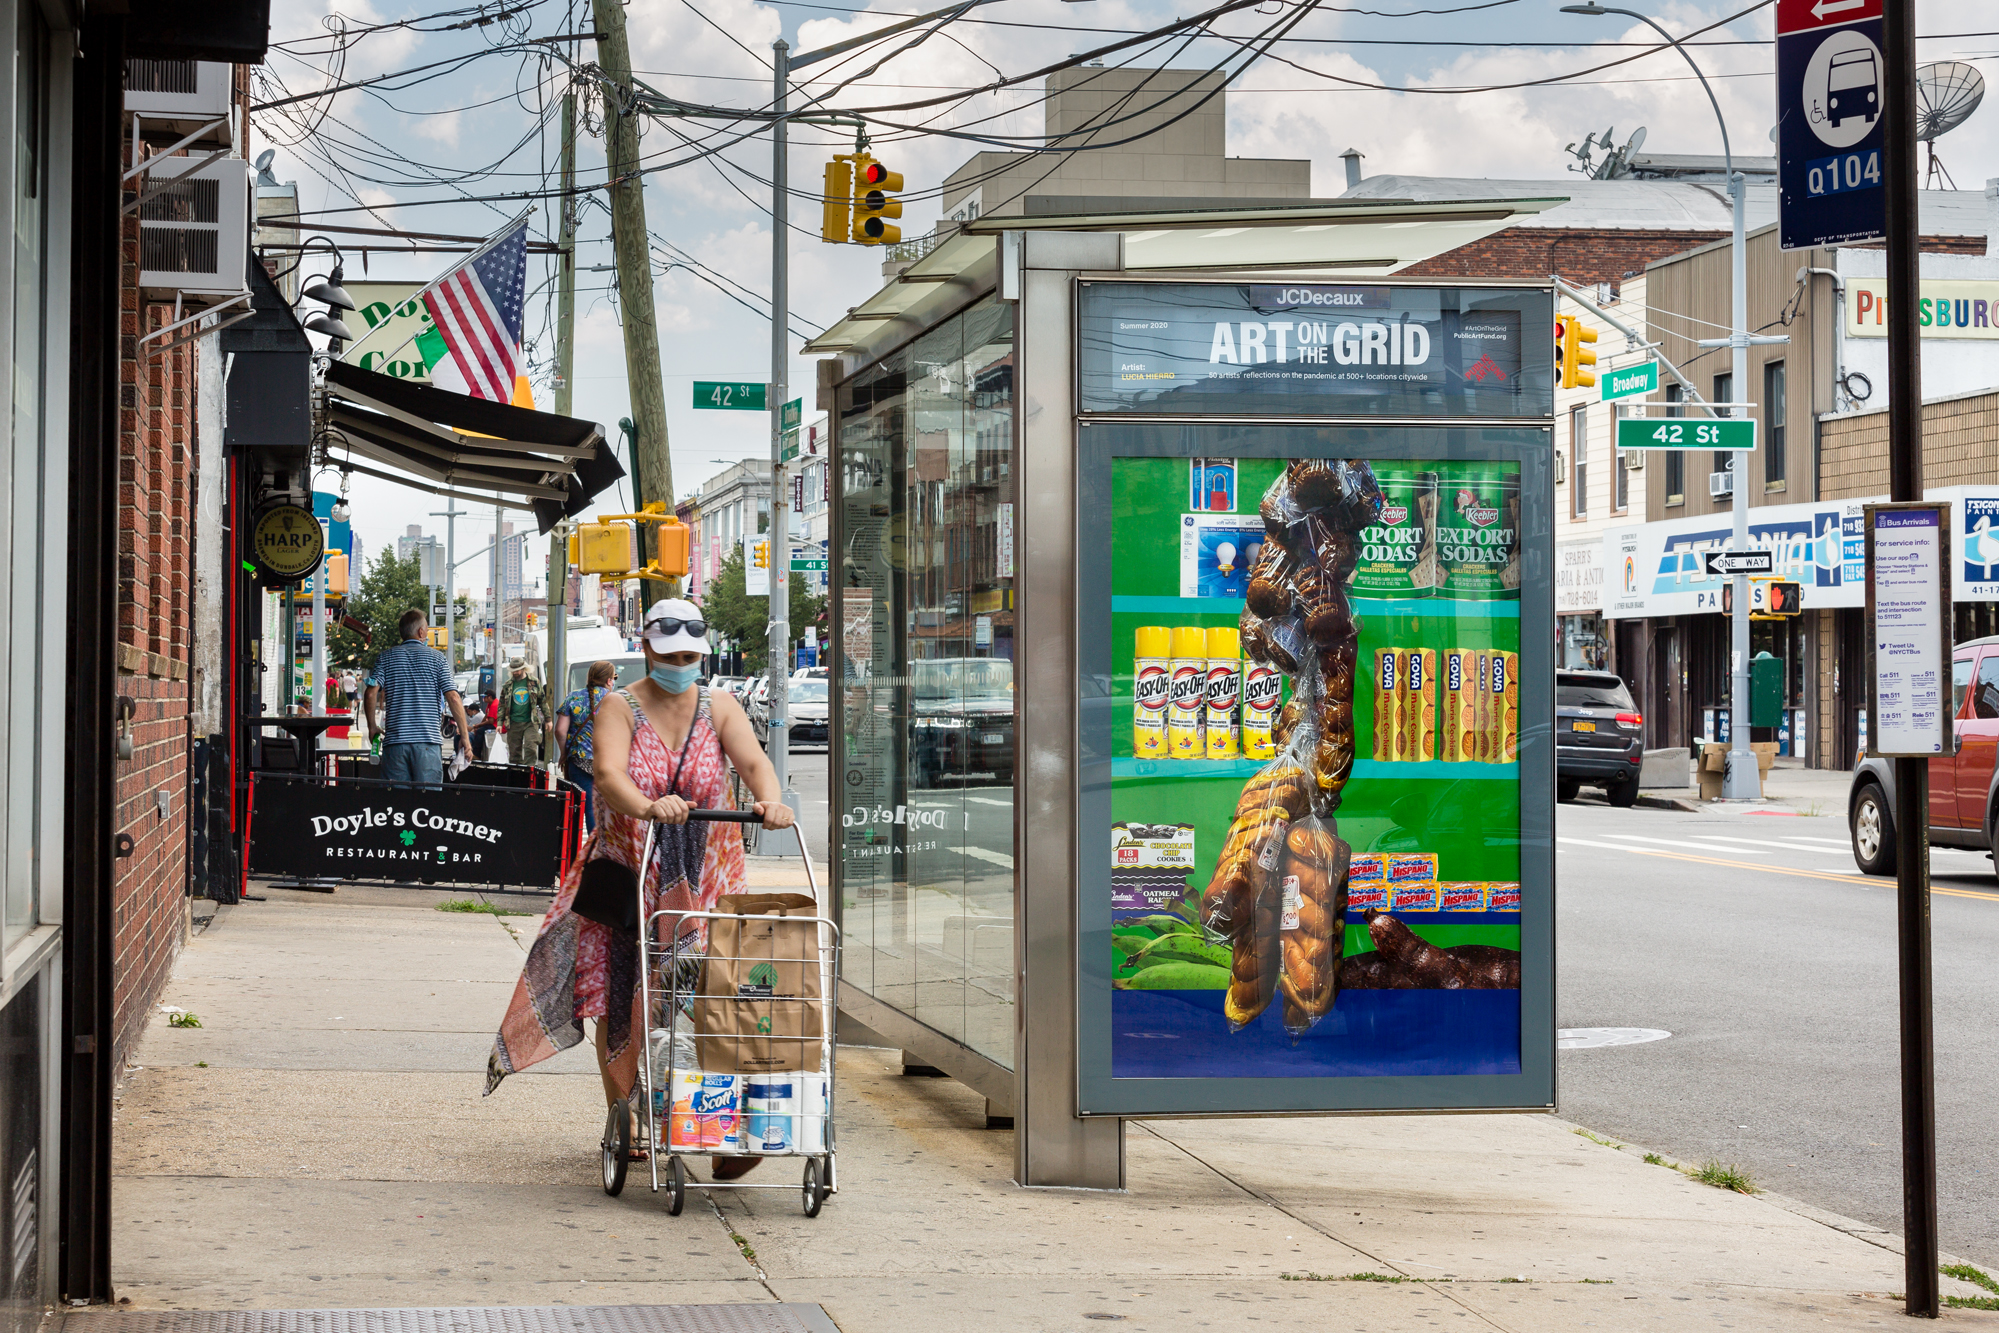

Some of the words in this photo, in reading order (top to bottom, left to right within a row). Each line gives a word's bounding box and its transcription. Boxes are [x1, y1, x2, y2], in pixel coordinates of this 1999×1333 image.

[1807, 151, 1881, 195] Q104
[1836, 230, 1880, 240] TRANSPORTATION
[1276, 288, 1364, 305] JCDecaux
[1120, 322, 1149, 330] Summer
[1297, 321, 1327, 344] ON
[1209, 322, 1294, 364] ART
[1332, 322, 1431, 365] GRID
[1453, 332, 1507, 341] PublicArtFund.org
[1296, 346, 1328, 364] THE
[1121, 363, 1146, 371] Artist:
[1465, 353, 1490, 380] PUBLIC
[1475, 365, 1490, 382] ART
[1488, 360, 1507, 381] FUND
[1121, 373, 1145, 381] LUCIA
[1146, 372, 1175, 380] HIERRO
[1219, 371, 1242, 379] artists'
[1243, 371, 1280, 379] reflections
[1304, 372, 1337, 381] pandemic
[1346, 372, 1365, 380] 500+
[1398, 373, 1428, 382] citywide
[1612, 371, 1648, 393] Broadway
[711, 386, 733, 406] 42
[740, 385, 750, 397] St
[1652, 425, 1683, 443] 42
[1696, 425, 1720, 443] St
[258, 509, 282, 535] IMPORTED
[282, 507, 300, 516] FROM
[300, 513, 318, 535] IRELAND
[1467, 508, 1498, 521] Keebler
[1887, 519, 1901, 527] Bus
[1902, 518, 1930, 526] Arrivals
[264, 532, 313, 548] HARP
[1359, 527, 1423, 544] XPORT
[1435, 528, 1514, 545] EXPORT
[1875, 540, 1887, 548] For
[1888, 539, 1913, 547] service
[1359, 545, 1417, 562] ODAS
[1442, 546, 1508, 563] SODAS
[1564, 550, 1592, 566] SPARR'S
[805, 561, 816, 569] 41
[1718, 558, 1737, 568] ONE
[1745, 557, 1766, 567] WAY
[1576, 569, 1581, 586] &
[1383, 655, 1393, 688] GOYA
[1411, 655, 1420, 689] GOYA
[1450, 655, 1459, 689] GOYA
[1493, 658, 1503, 692] GOYA
[1170, 675, 1206, 700] EASY-OFF
[1207, 676, 1238, 700] ASY-OFF
[1245, 676, 1280, 701] EASY-OFF
[1382, 723, 1391, 757] Cookies
[311, 806, 406, 838] Doyle's
[411, 807, 503, 845] Corner
[1123, 849, 1134, 857] 18
[1149, 842, 1193, 850] CHOCOLATE
[1162, 849, 1181, 857] CHIP
[326, 847, 430, 862] RESTAURANT
[452, 851, 482, 863] BAR
[1350, 864, 1378, 877] ISPANO
[1392, 864, 1428, 878] HISPANO
[1396, 893, 1431, 906] HISPANO
[1443, 893, 1479, 906] HISPANO
[698, 1089, 733, 1113] Scott
